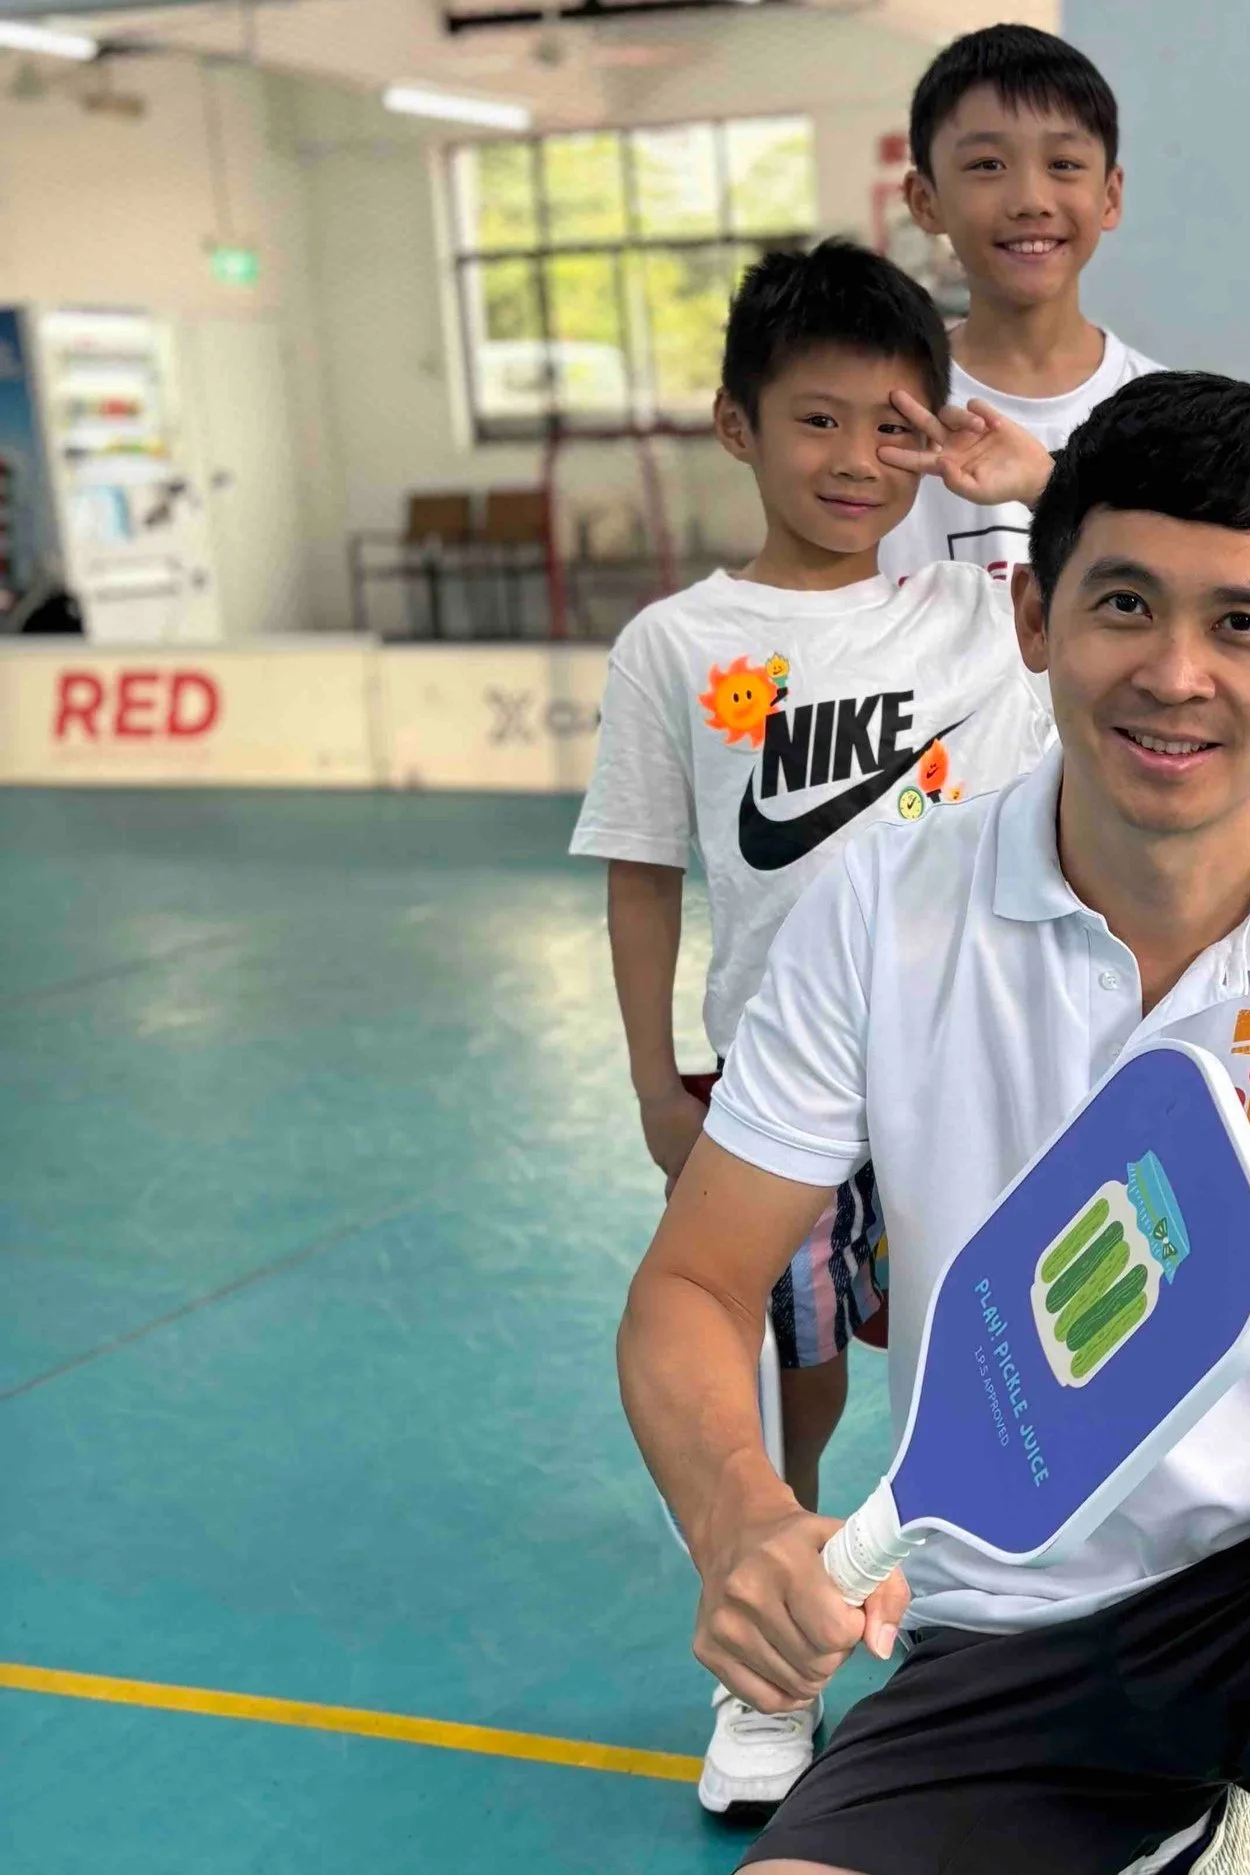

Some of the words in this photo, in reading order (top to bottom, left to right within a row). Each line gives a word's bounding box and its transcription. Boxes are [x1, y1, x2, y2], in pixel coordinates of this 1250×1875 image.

[52, 670, 220, 741] RED
[761, 690, 914, 800] NIKE
[974, 1278, 1008, 1341] PLAY!
[993, 1341, 1028, 1419] PICKLE
[1020, 1424, 1049, 1488] JUICE
[983, 1377, 1009, 1447] APPROVED
